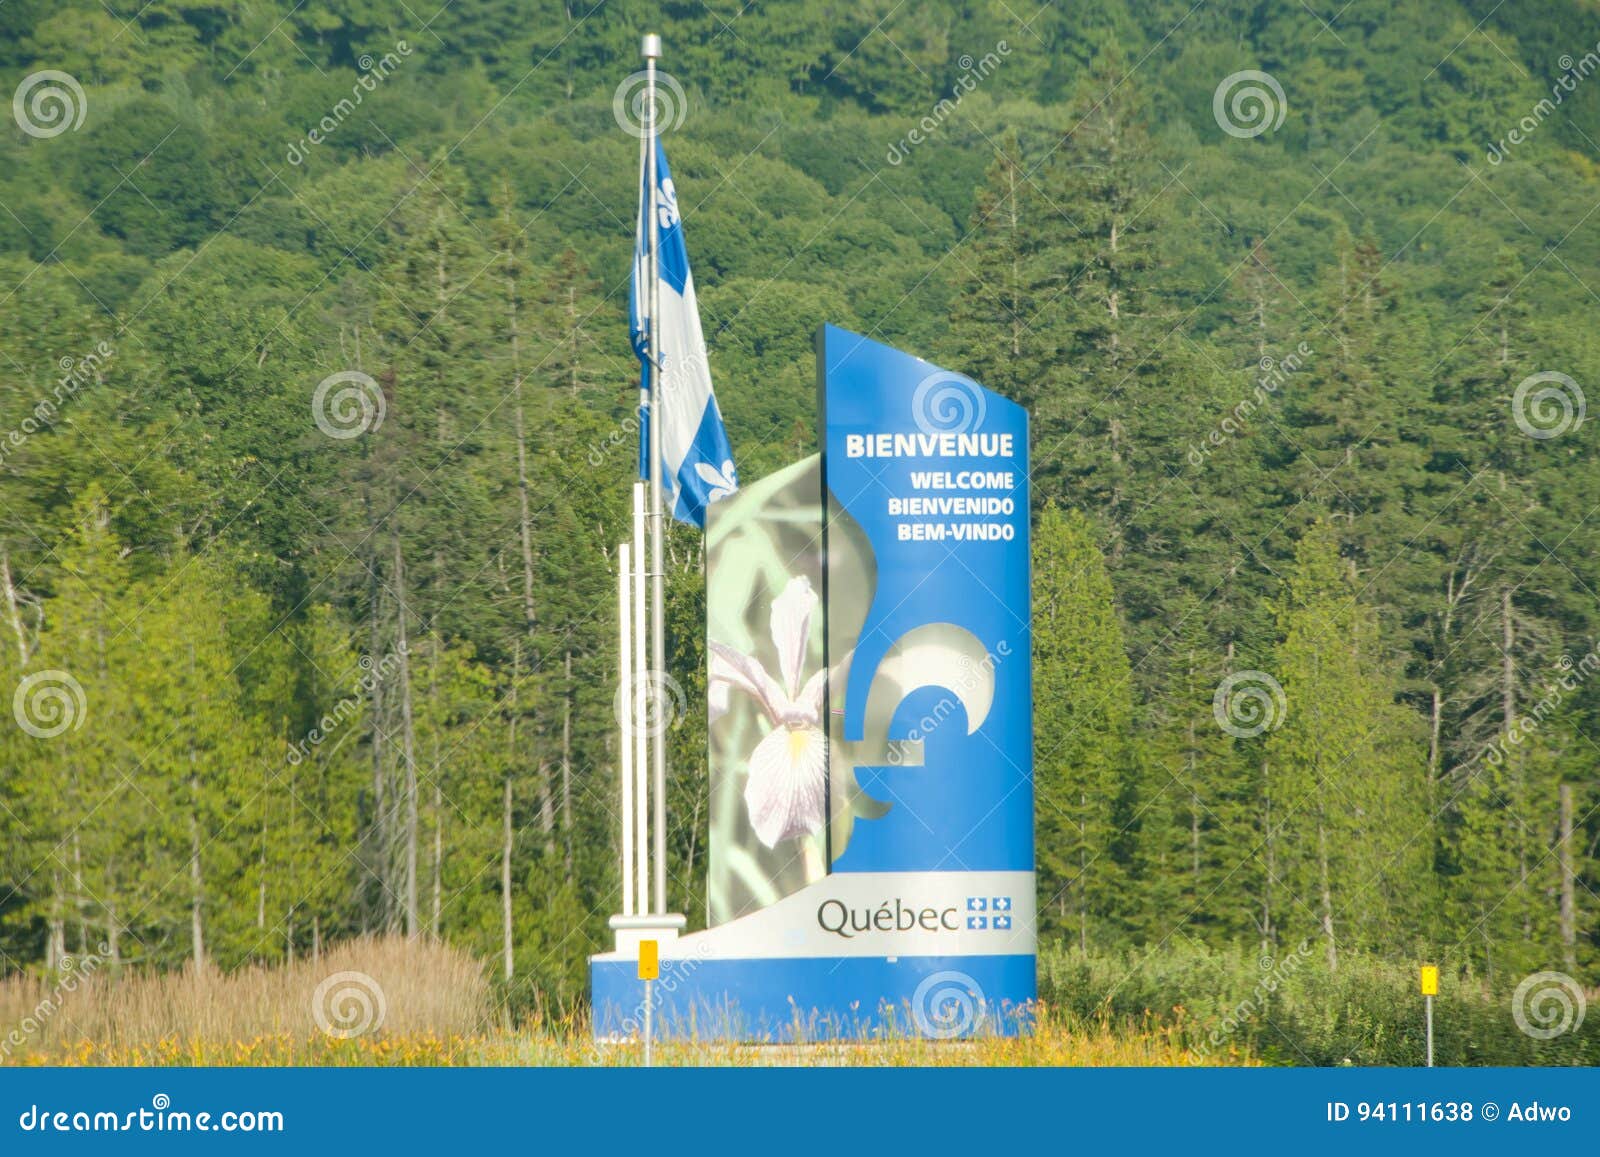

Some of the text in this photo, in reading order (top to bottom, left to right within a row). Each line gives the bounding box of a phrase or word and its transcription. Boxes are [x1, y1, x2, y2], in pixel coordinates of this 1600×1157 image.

[846, 433, 1013, 458] BIENVENUE
[910, 472, 1014, 489] WELCOME
[888, 497, 1014, 515] BIENVENIDO
[897, 523, 1014, 541] BEM-VINDO
[817, 898, 959, 938] Québec
